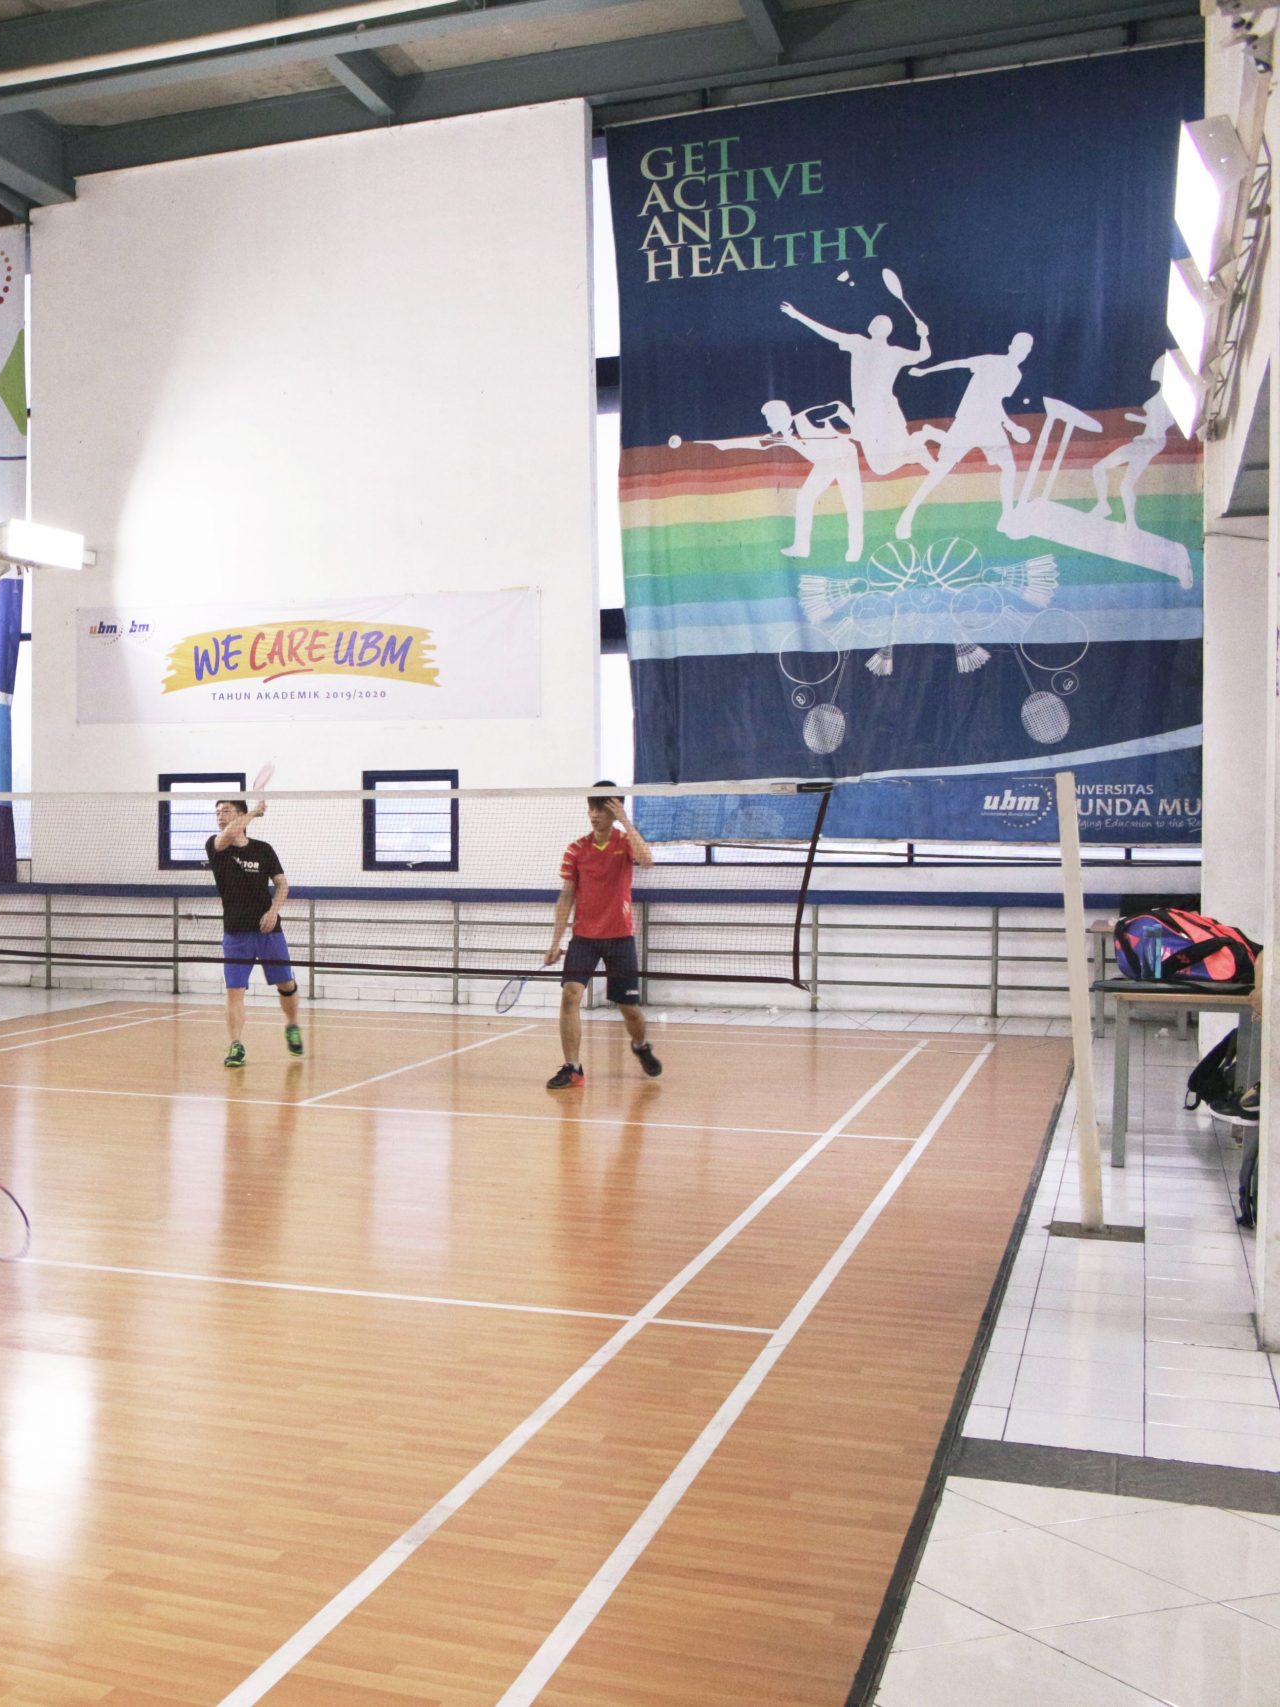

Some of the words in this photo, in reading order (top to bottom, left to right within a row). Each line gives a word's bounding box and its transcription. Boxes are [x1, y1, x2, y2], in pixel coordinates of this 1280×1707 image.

[640, 136, 740, 181] GET
[637, 160, 824, 217] ACTIVE
[638, 204, 757, 250] AND
[644, 223, 888, 283] HEALTHY
[89, 620, 118, 635] ubm
[194, 634, 242, 681] WE
[249, 627, 329, 672] CARE
[332, 630, 414, 673] UBM
[212, 691, 251, 701] TAHUN
[256, 690, 320, 700] AKADEMIK
[326, 689, 387, 701] 2019/2020
[983, 789, 1040, 811] ubm
[1075, 784, 1154, 795] NIVERSITAS
[1077, 798, 1151, 817] UNDA
